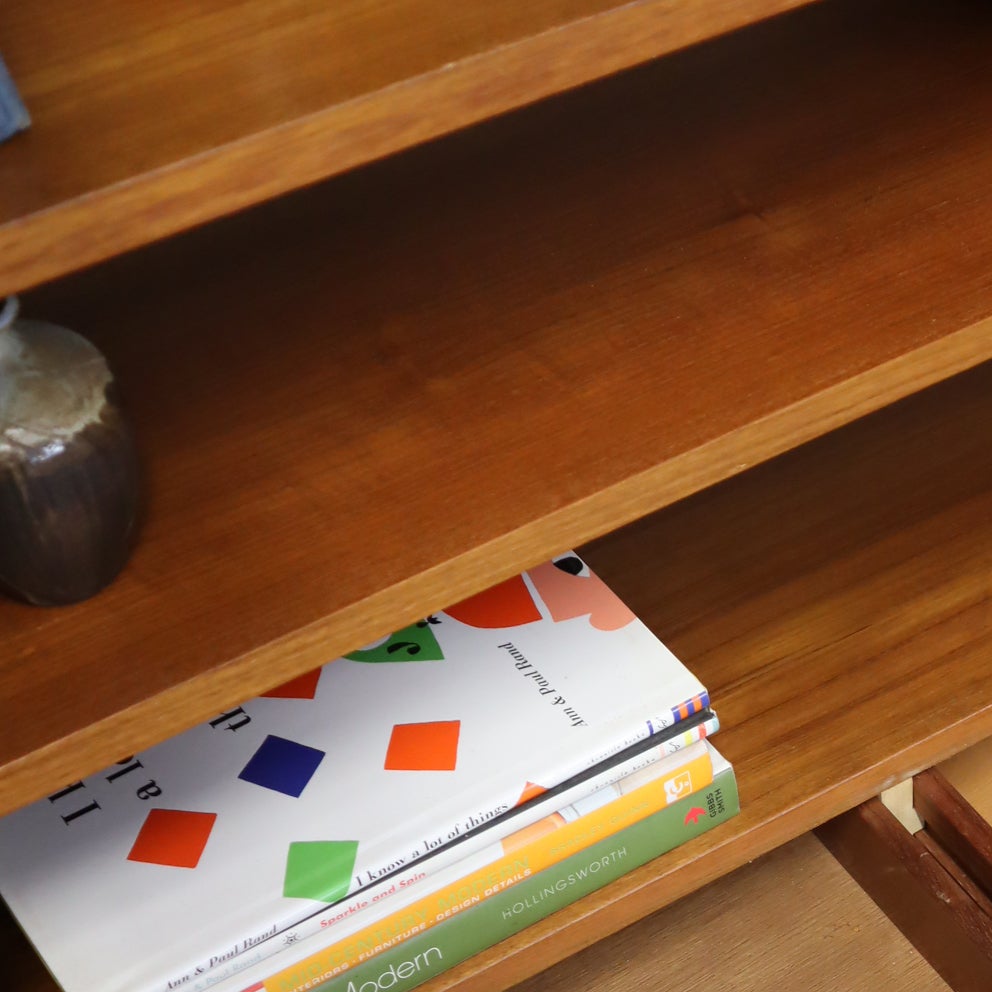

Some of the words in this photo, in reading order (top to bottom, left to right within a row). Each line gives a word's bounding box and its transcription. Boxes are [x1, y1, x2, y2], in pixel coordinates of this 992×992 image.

[497, 642, 533, 670] Rand
[524, 671, 556, 695] Paul
[550, 696, 566, 706] &
[563, 707, 591, 727] Ann
[706, 793, 717, 818] GIBBS
[714, 788, 725, 813] SMITH
[163, 972, 190, 990] Ann
[192, 964, 205, 975] &
[206, 944, 240, 968] Paul
[240, 923, 279, 949] Rand
[355, 875, 363, 886] I
[365, 853, 406, 881] know
[410, 849, 420, 858] a
[422, 833, 443, 851] lot
[444, 822, 464, 839] of
[462, 799, 509, 831] things
[435, 854, 533, 911] MODERN
[502, 847, 628, 920] HOLLINGSWORTH
[318, 898, 369, 928] Sparkle
[370, 884, 396, 902] and
[397, 870, 426, 890] Spin
[358, 921, 427, 961] FURNITURE
[434, 894, 480, 922] DESIGN
[483, 867, 532, 897] DETAILS
